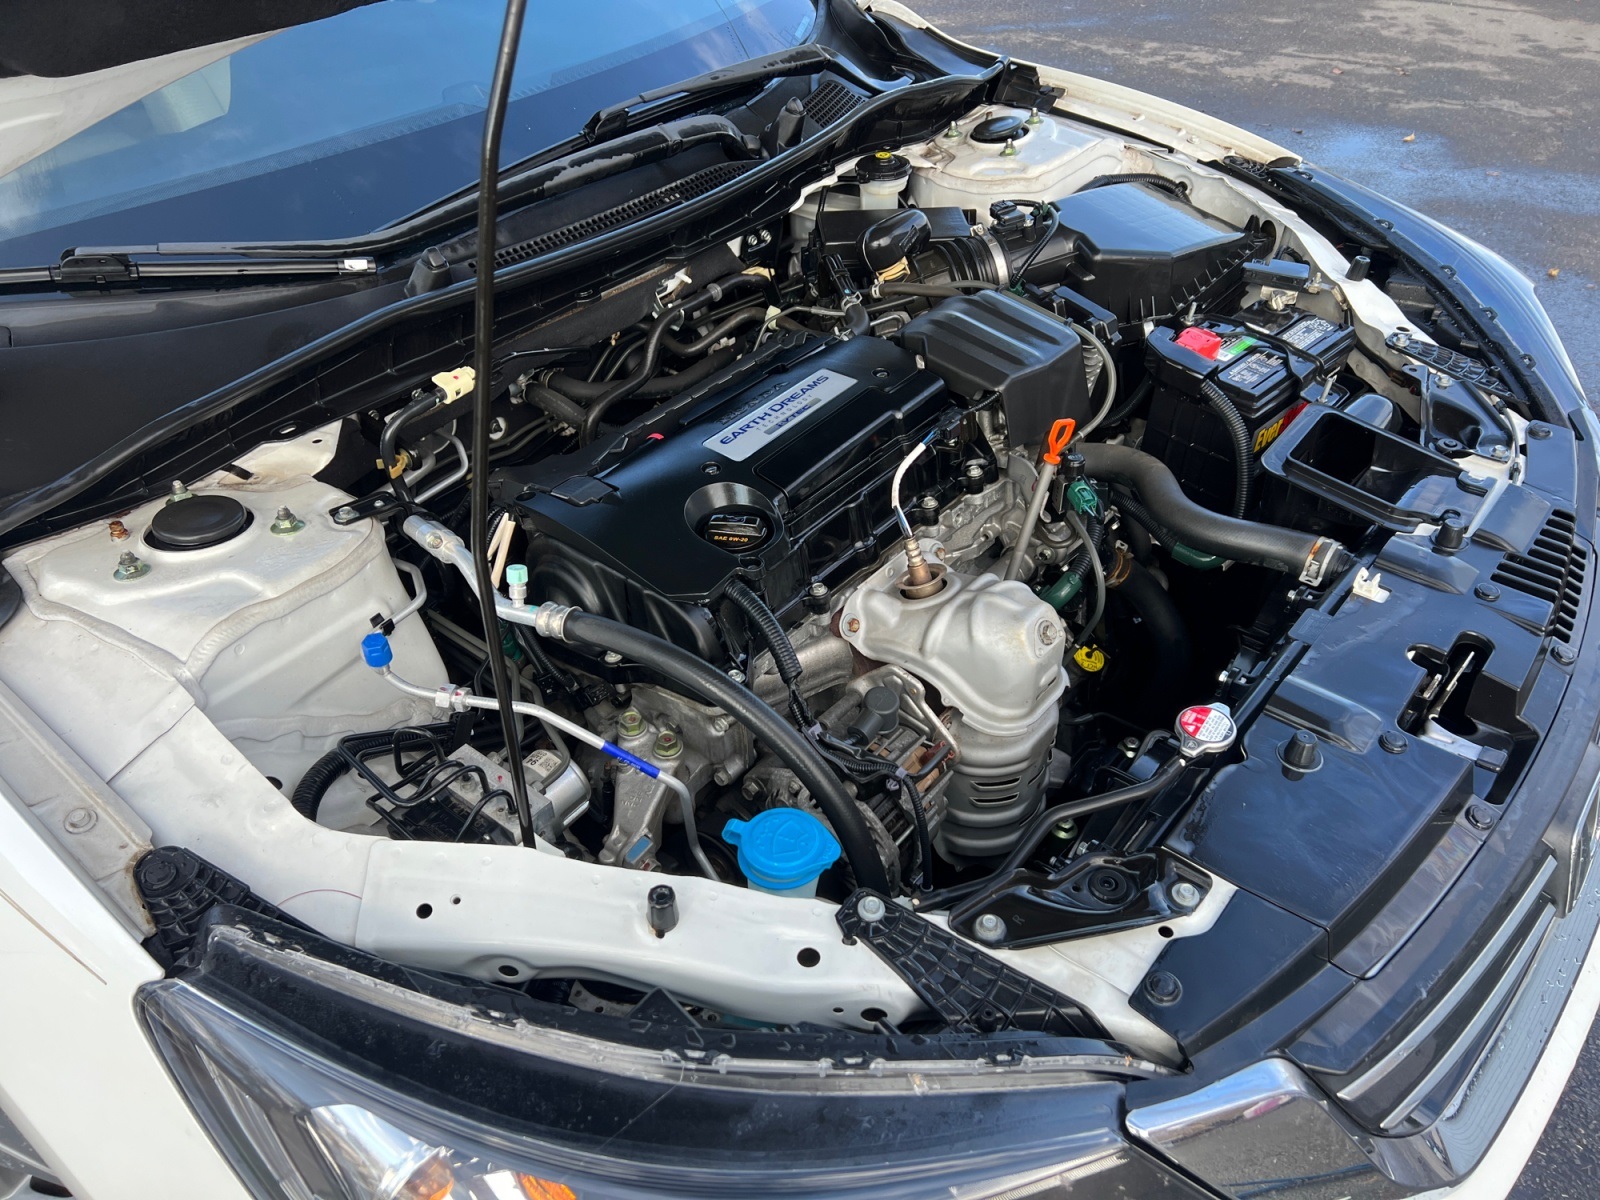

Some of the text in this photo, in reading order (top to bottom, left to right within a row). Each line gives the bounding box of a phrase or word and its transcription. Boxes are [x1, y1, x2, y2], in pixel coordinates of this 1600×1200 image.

[719, 375, 830, 445] EARTH DREAMS
[756, 394, 813, 431] TECHNOLOGY
